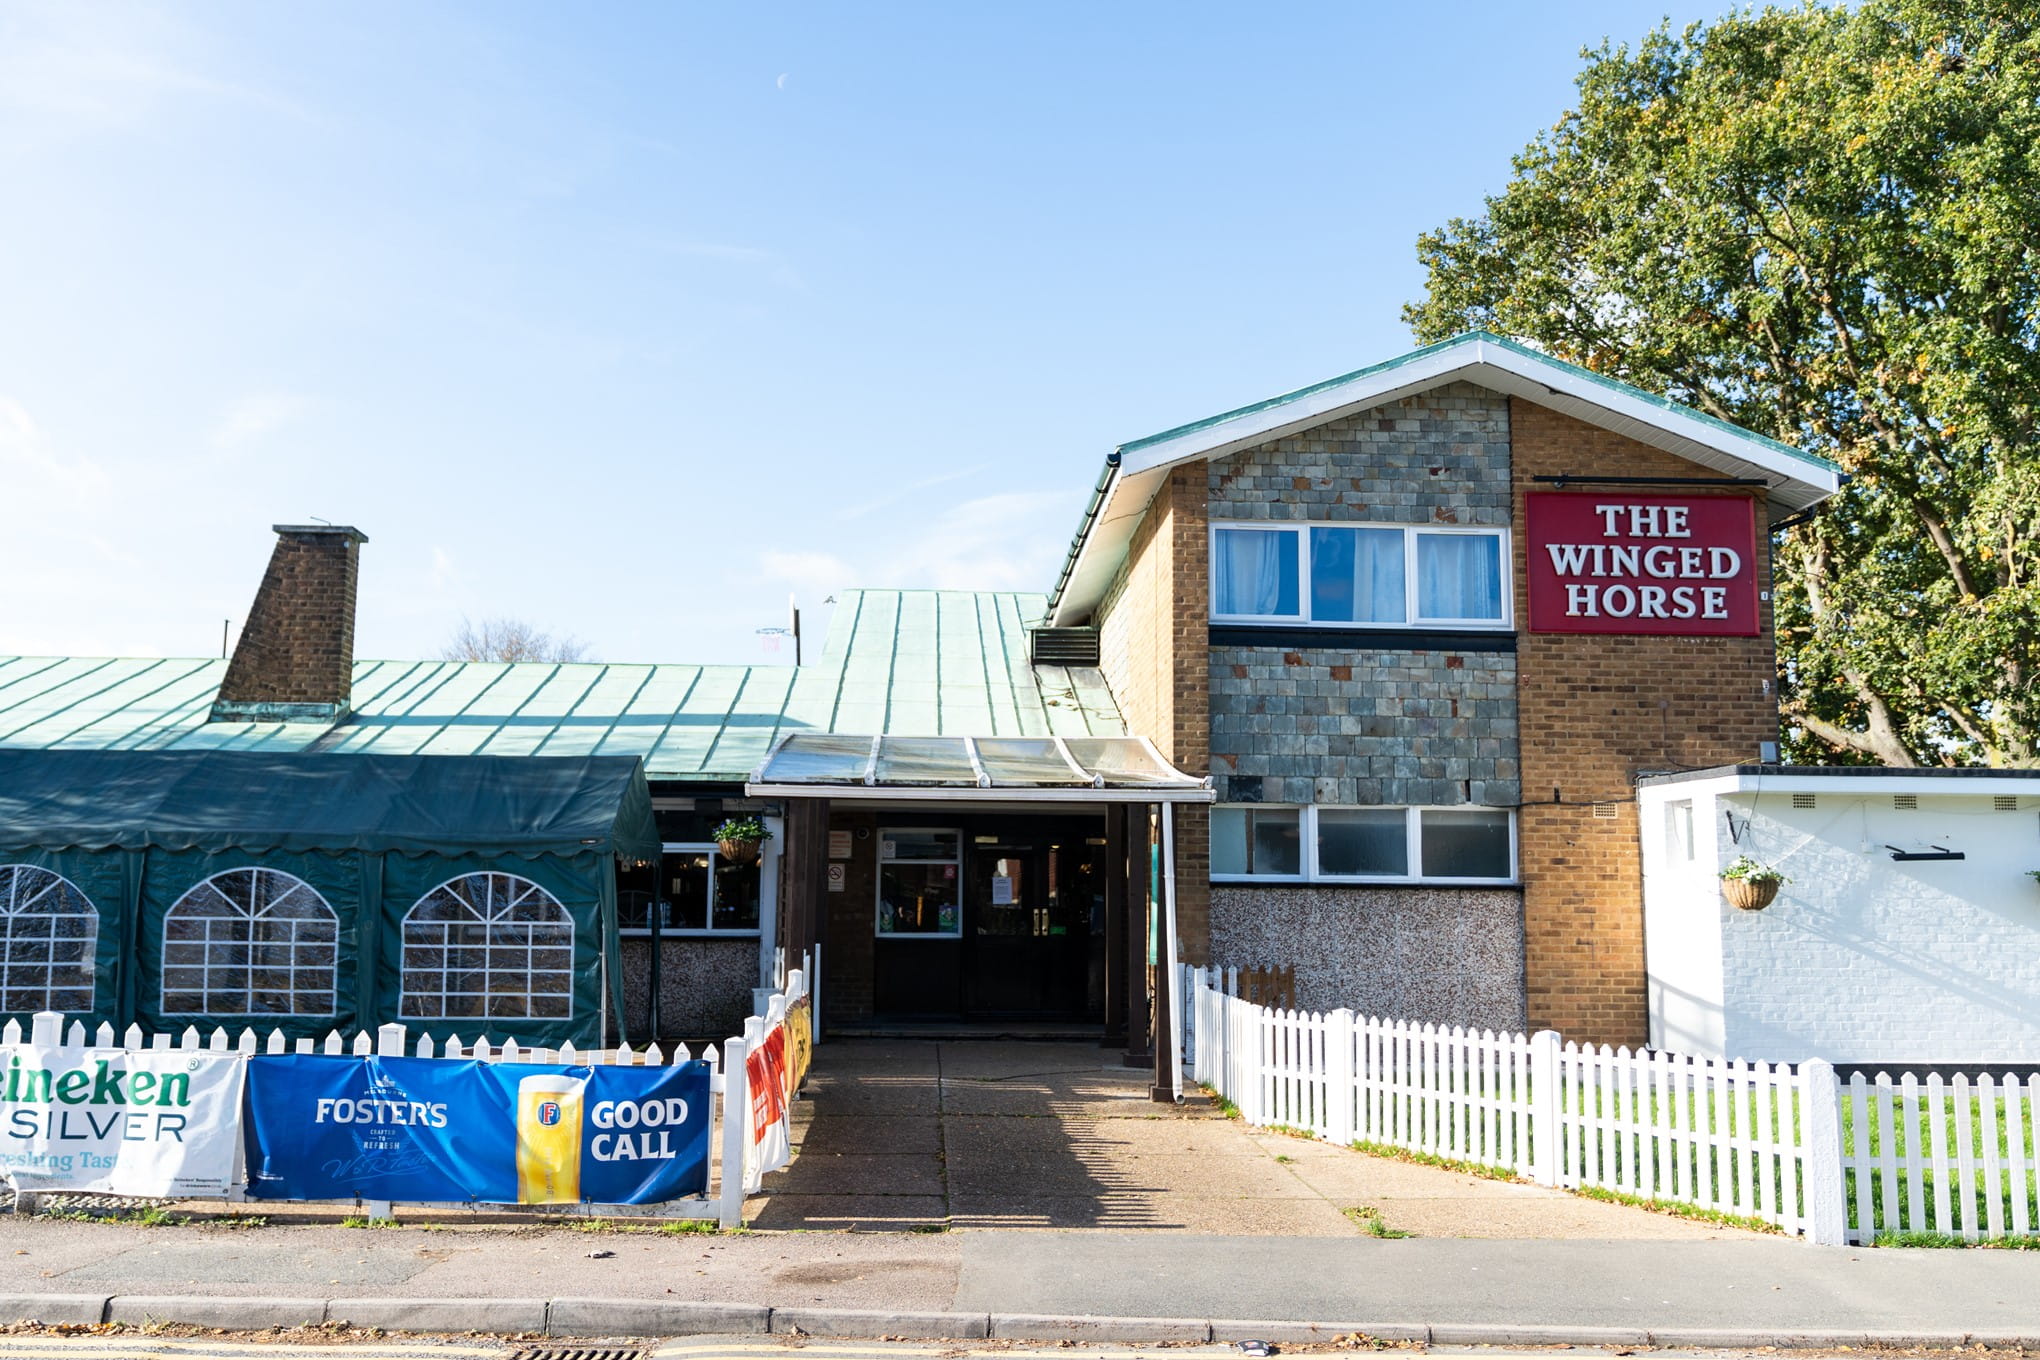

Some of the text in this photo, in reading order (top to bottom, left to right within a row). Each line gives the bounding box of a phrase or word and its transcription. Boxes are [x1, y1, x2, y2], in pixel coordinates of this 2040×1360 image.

[1596, 505, 1691, 538] THE
[1545, 544, 1741, 579] WINGED
[1565, 584, 1728, 619] HORSE
[0, 1056, 192, 1107] ineken
[8, 1109, 187, 1142] SILVER
[315, 1098, 448, 1128] FOSTER'S
[591, 1098, 689, 1129] GOOD
[363, 1141, 400, 1150] REFRESH
[591, 1131, 676, 1161] CALL
